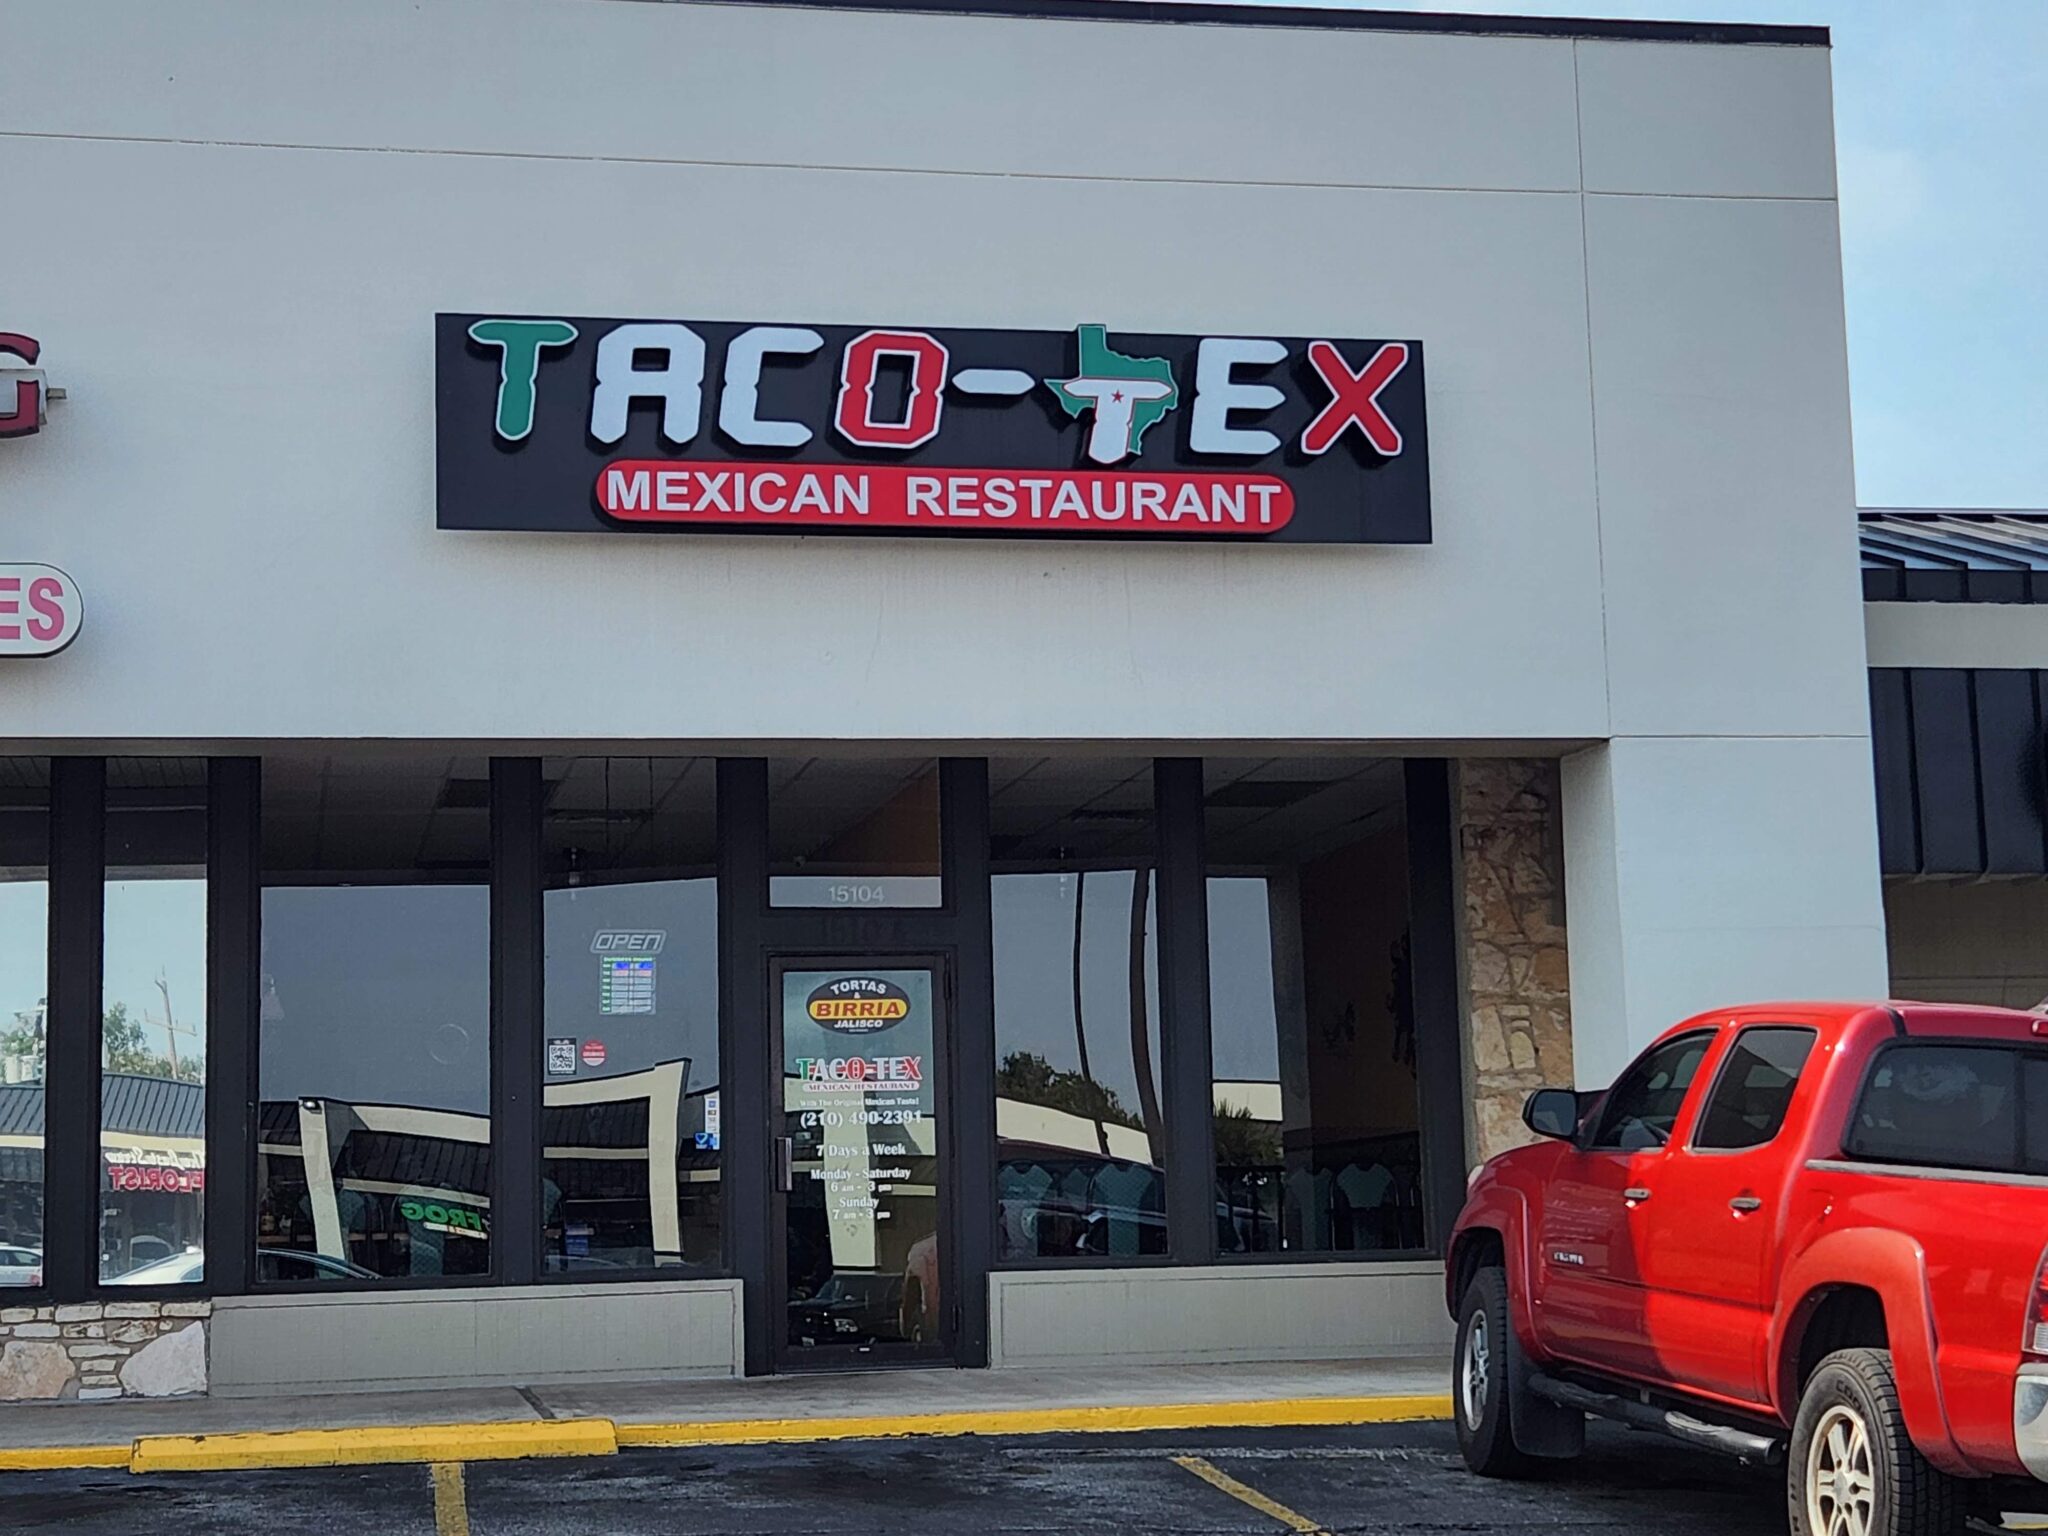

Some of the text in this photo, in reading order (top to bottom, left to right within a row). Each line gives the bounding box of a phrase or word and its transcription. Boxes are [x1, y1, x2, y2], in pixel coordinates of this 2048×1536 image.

[467, 318, 1409, 464] TACO-TEX
[606, 469, 1282, 525] MEXICAN RESTAURANT
[828, 885, 885, 903] 15104
[595, 934, 661, 950] OPEN
[830, 980, 887, 995] TORTAS
[816, 1002, 900, 1017] BIRRIA
[834, 1019, 884, 1028] JALISCO
[796, 1056, 922, 1081] TACO-TEX
[854, 1082, 915, 1090] RESTAURANT
[801, 1110, 921, 1129] (210) 490-2391
[816, 1143, 907, 1158] 7 Days a Week
[810, 1168, 852, 1181] Monday
[862, 1167, 911, 1180] Saturday
[868, 1181, 876, 1191] 3
[840, 1197, 880, 1209] Sunday
[832, 1209, 840, 1220] 7
[866, 1208, 874, 1218] 3
